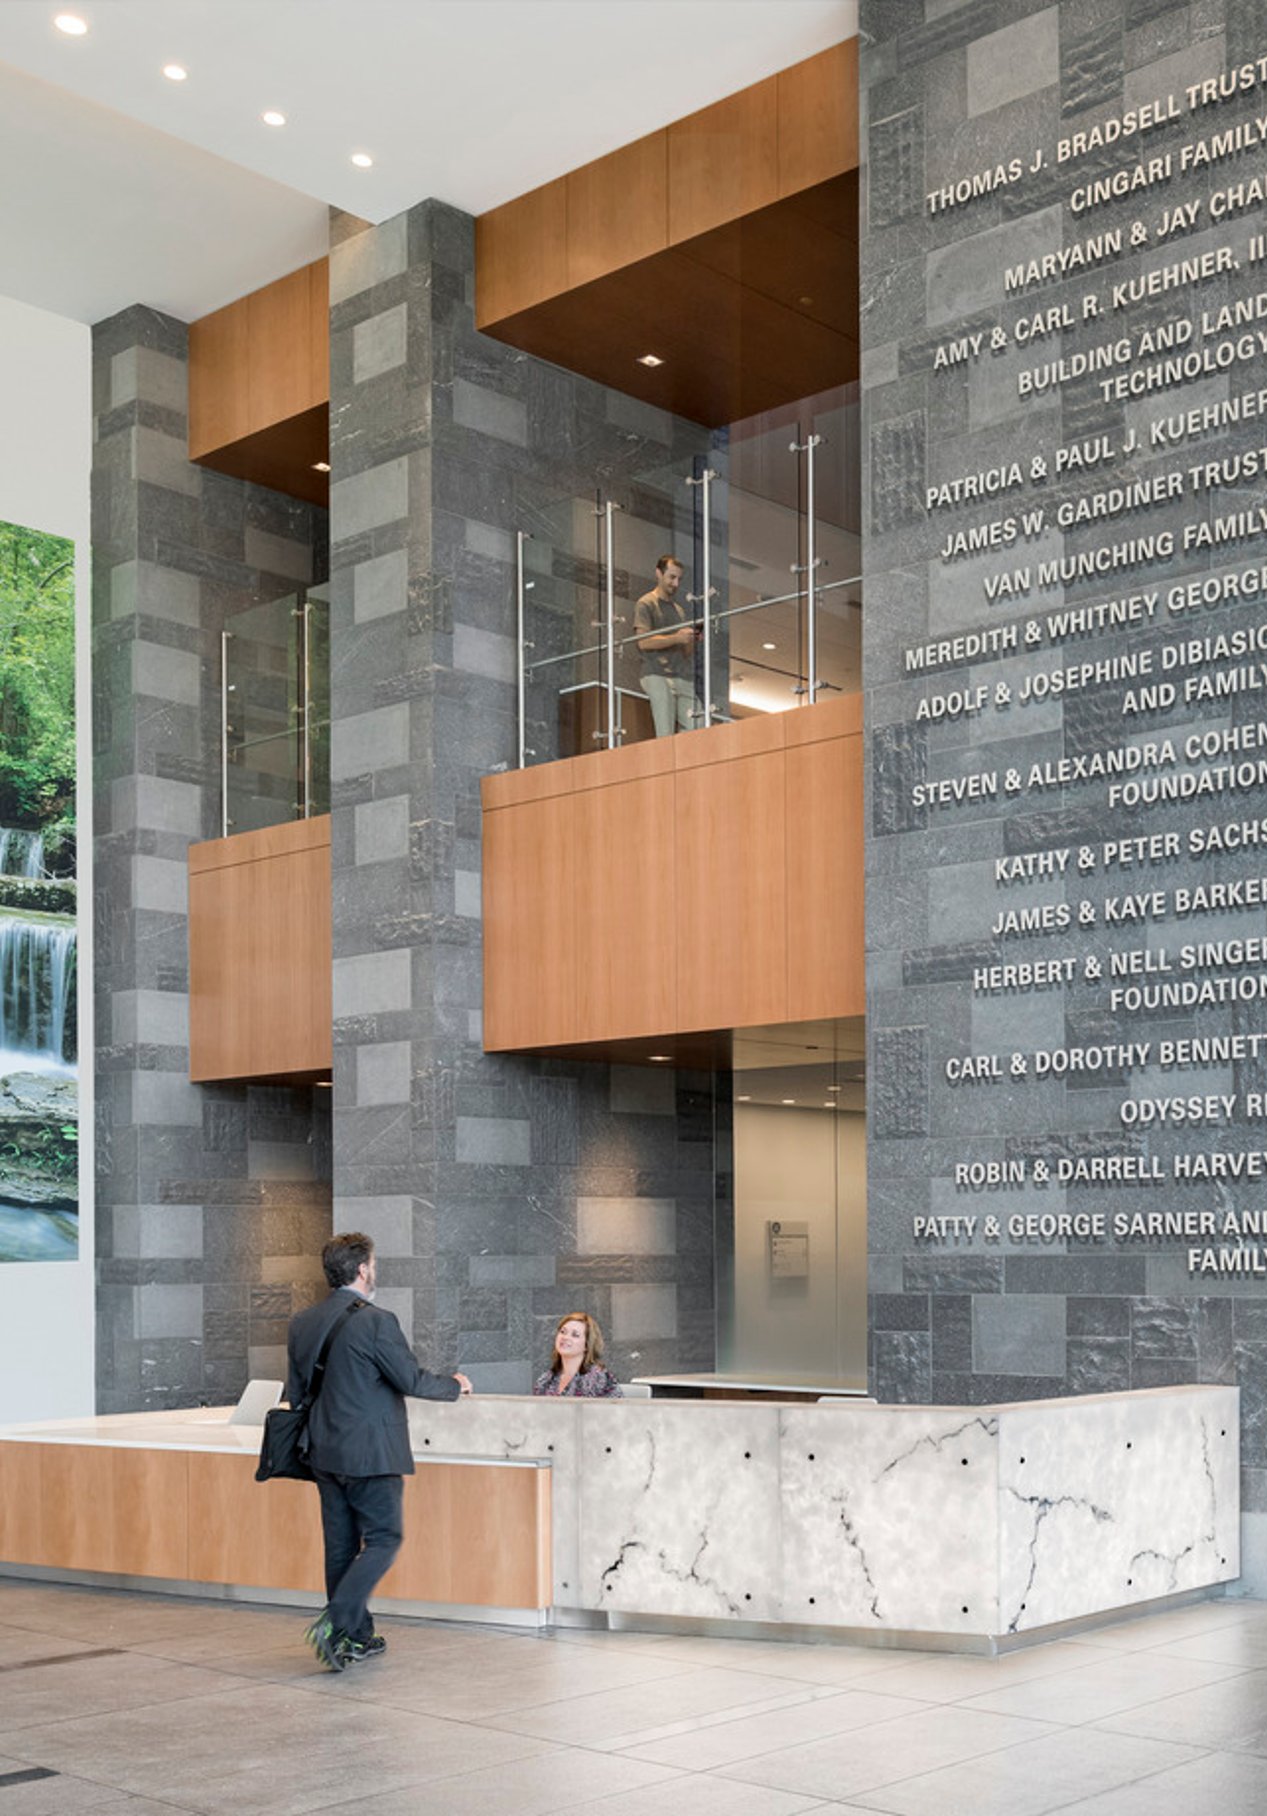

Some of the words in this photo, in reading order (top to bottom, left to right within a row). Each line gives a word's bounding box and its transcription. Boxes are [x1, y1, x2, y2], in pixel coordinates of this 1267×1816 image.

[928, 156, 1022, 213] THOMAS
[1030, 146, 1047, 174] J.
[1058, 92, 1181, 163] BRADSELL
[1070, 151, 1172, 212] CINGARI
[1005, 228, 1121, 290] MARYANN
[1131, 219, 1147, 246] &
[1157, 200, 1200, 237] JAY
[934, 332, 981, 369] AMY
[990, 323, 1007, 351] &
[1015, 301, 1074, 342] CARL
[1083, 291, 1103, 319] R.
[1112, 245, 1240, 309] KUEHNER,
[1018, 338, 1131, 394] BUILDING
[1139, 319, 1192, 357] AND
[927, 461, 1023, 509] PATRICIA
[1030, 454, 1046, 480] &
[1056, 435, 1114, 472] PAUL
[1123, 427, 1141, 453] J.
[942, 516, 1016, 558] JAMES
[1022, 507, 1049, 536] W.
[1058, 471, 1183, 527] GARDINER
[984, 567, 1030, 598] VAN
[1038, 531, 1173, 585] MUNCHING
[906, 625, 1016, 670] MEREDITH
[1025, 619, 1041, 644] &
[1047, 593, 1158, 639] WHITNEY
[917, 686, 987, 720] ADOLF
[995, 681, 1011, 704] &
[1019, 651, 1152, 699] JOSEPHINE
[1123, 683, 1175, 713] AND
[912, 772, 996, 807] STEVEN
[1005, 767, 1021, 791] &
[1028, 739, 1176, 787] ALEXANDRA
[996, 849, 1069, 880] KATHY
[1078, 845, 1095, 869] &
[1104, 833, 1179, 865] PETER
[993, 904, 1070, 934] JAMES
[1079, 901, 1096, 924] &
[1105, 892, 1165, 921] KAYE
[974, 959, 1076, 990] HERBERT
[1085, 956, 1101, 978] &
[1111, 949, 1171, 976] NELL
[946, 1054, 1002, 1080] CARL
[1011, 1053, 1027, 1075] &
[1035, 1043, 1150, 1074] DOROTHY
[1120, 1096, 1236, 1123] ODYSSEY
[955, 1161, 1025, 1184] ROBIN
[1033, 1160, 1049, 1181] &
[1059, 1156, 1164, 1180] DARRELL
[913, 1216, 977, 1237] PATTY
[985, 1216, 1000, 1236] &
[1008, 1214, 1104, 1236] GEORGE
[1114, 1212, 1215, 1235] SARNER
